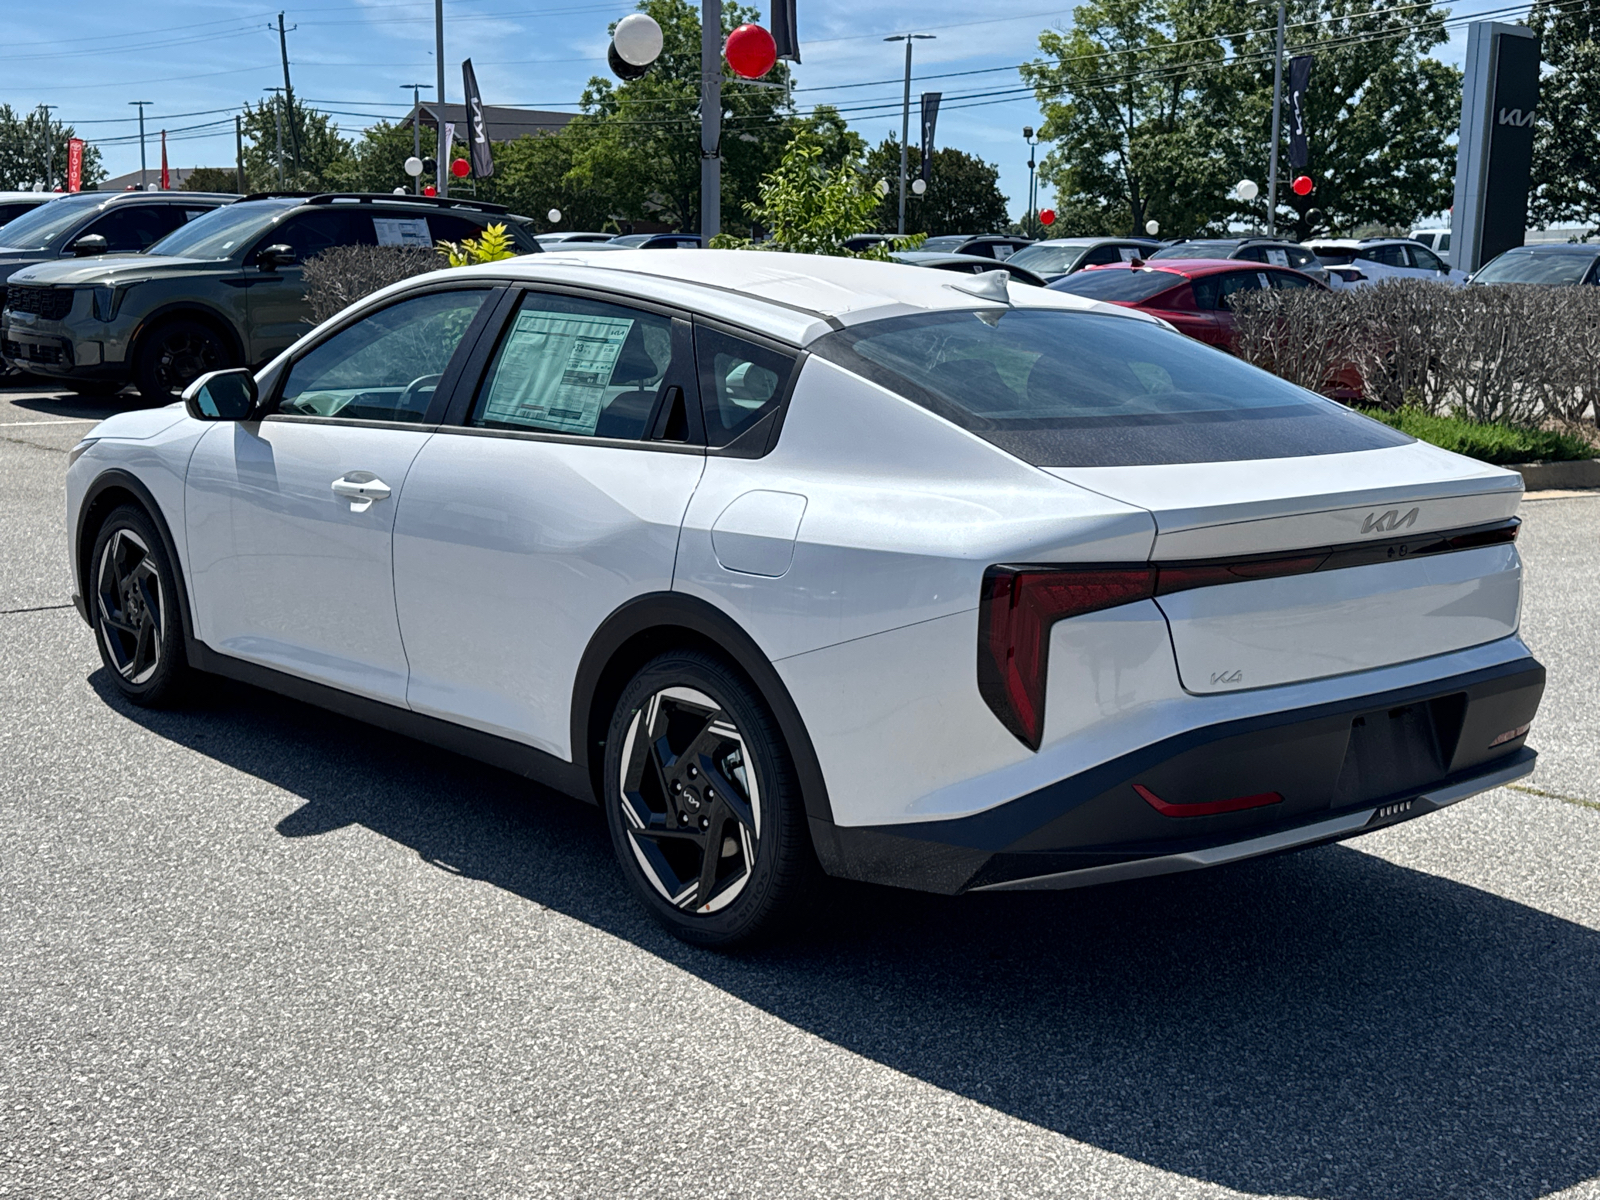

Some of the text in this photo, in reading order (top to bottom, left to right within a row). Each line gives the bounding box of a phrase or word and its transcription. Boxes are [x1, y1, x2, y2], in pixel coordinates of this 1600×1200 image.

[470, 97, 486, 144] KIA
[1499, 107, 1536, 128] KIA
[1361, 506, 1420, 535] KIA
[1210, 669, 1243, 686] K4
[612, 678, 642, 731] KUMHO
[683, 790, 700, 808] KIA
[737, 868, 768, 922] SOLUS
